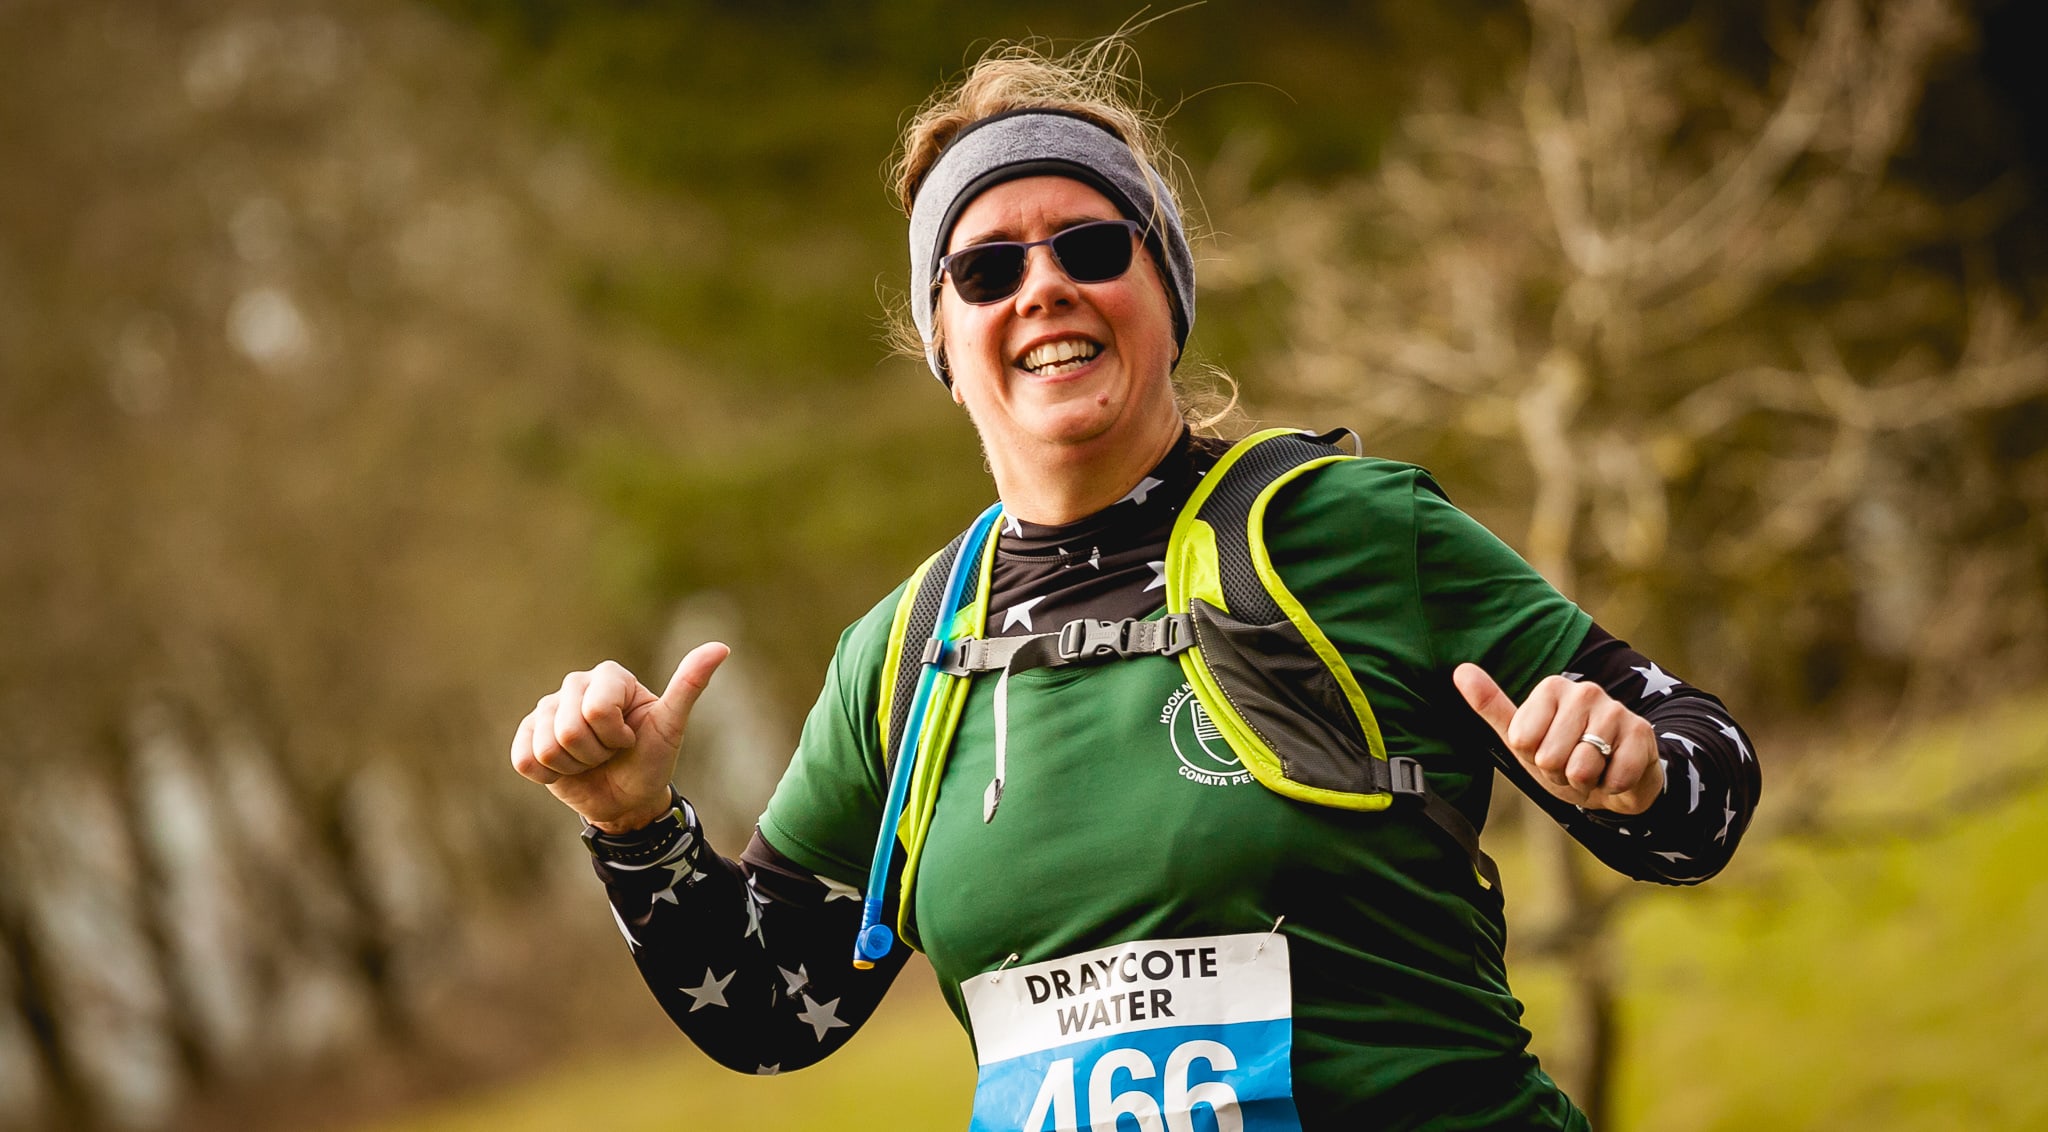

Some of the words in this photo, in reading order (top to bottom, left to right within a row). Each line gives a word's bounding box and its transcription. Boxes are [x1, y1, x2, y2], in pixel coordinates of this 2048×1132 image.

[1160, 689, 1184, 723] HOOK
[1181, 681, 1193, 693] N
[1178, 766, 1228, 786] CONATA
[1232, 772, 1255, 786] PE
[1025, 947, 1218, 1005] DRAYCOTE
[1057, 988, 1175, 1036] WATER
[1023, 1039, 1244, 1132] 466
